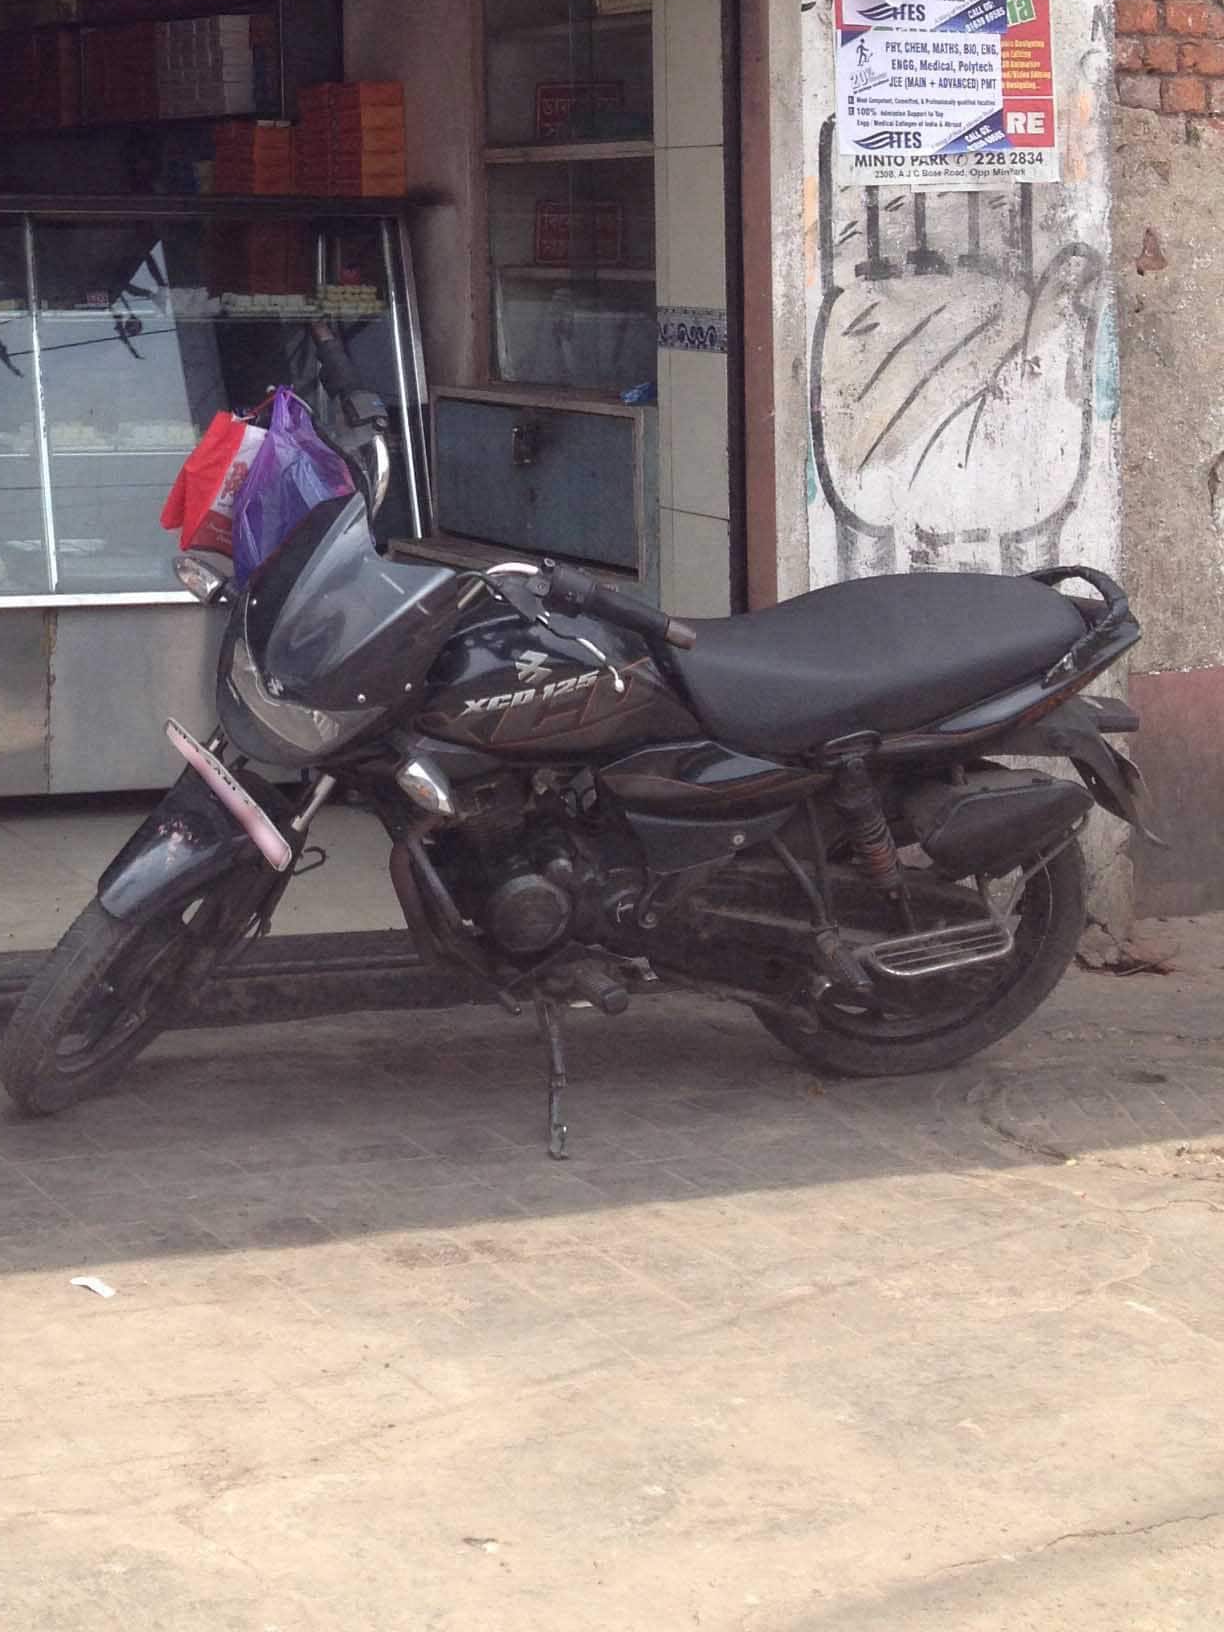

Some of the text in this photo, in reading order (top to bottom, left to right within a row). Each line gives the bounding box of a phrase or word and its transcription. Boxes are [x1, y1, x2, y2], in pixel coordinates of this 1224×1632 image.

[905, 43, 930, 54] CHEM,
[933, 44, 961, 55] MATHS,
[964, 44, 979, 56] BIO,
[920, 60, 956, 72] Medical,
[959, 61, 993, 74] Polytech
[939, 78, 979, 90] ADVANCED)
[981, 79, 996, 89] PMT
[855, 152, 1044, 168] MINTO PARK 228 2834
[969, 169, 990, 177] Opp
[456, 670, 600, 720] XCD 125
